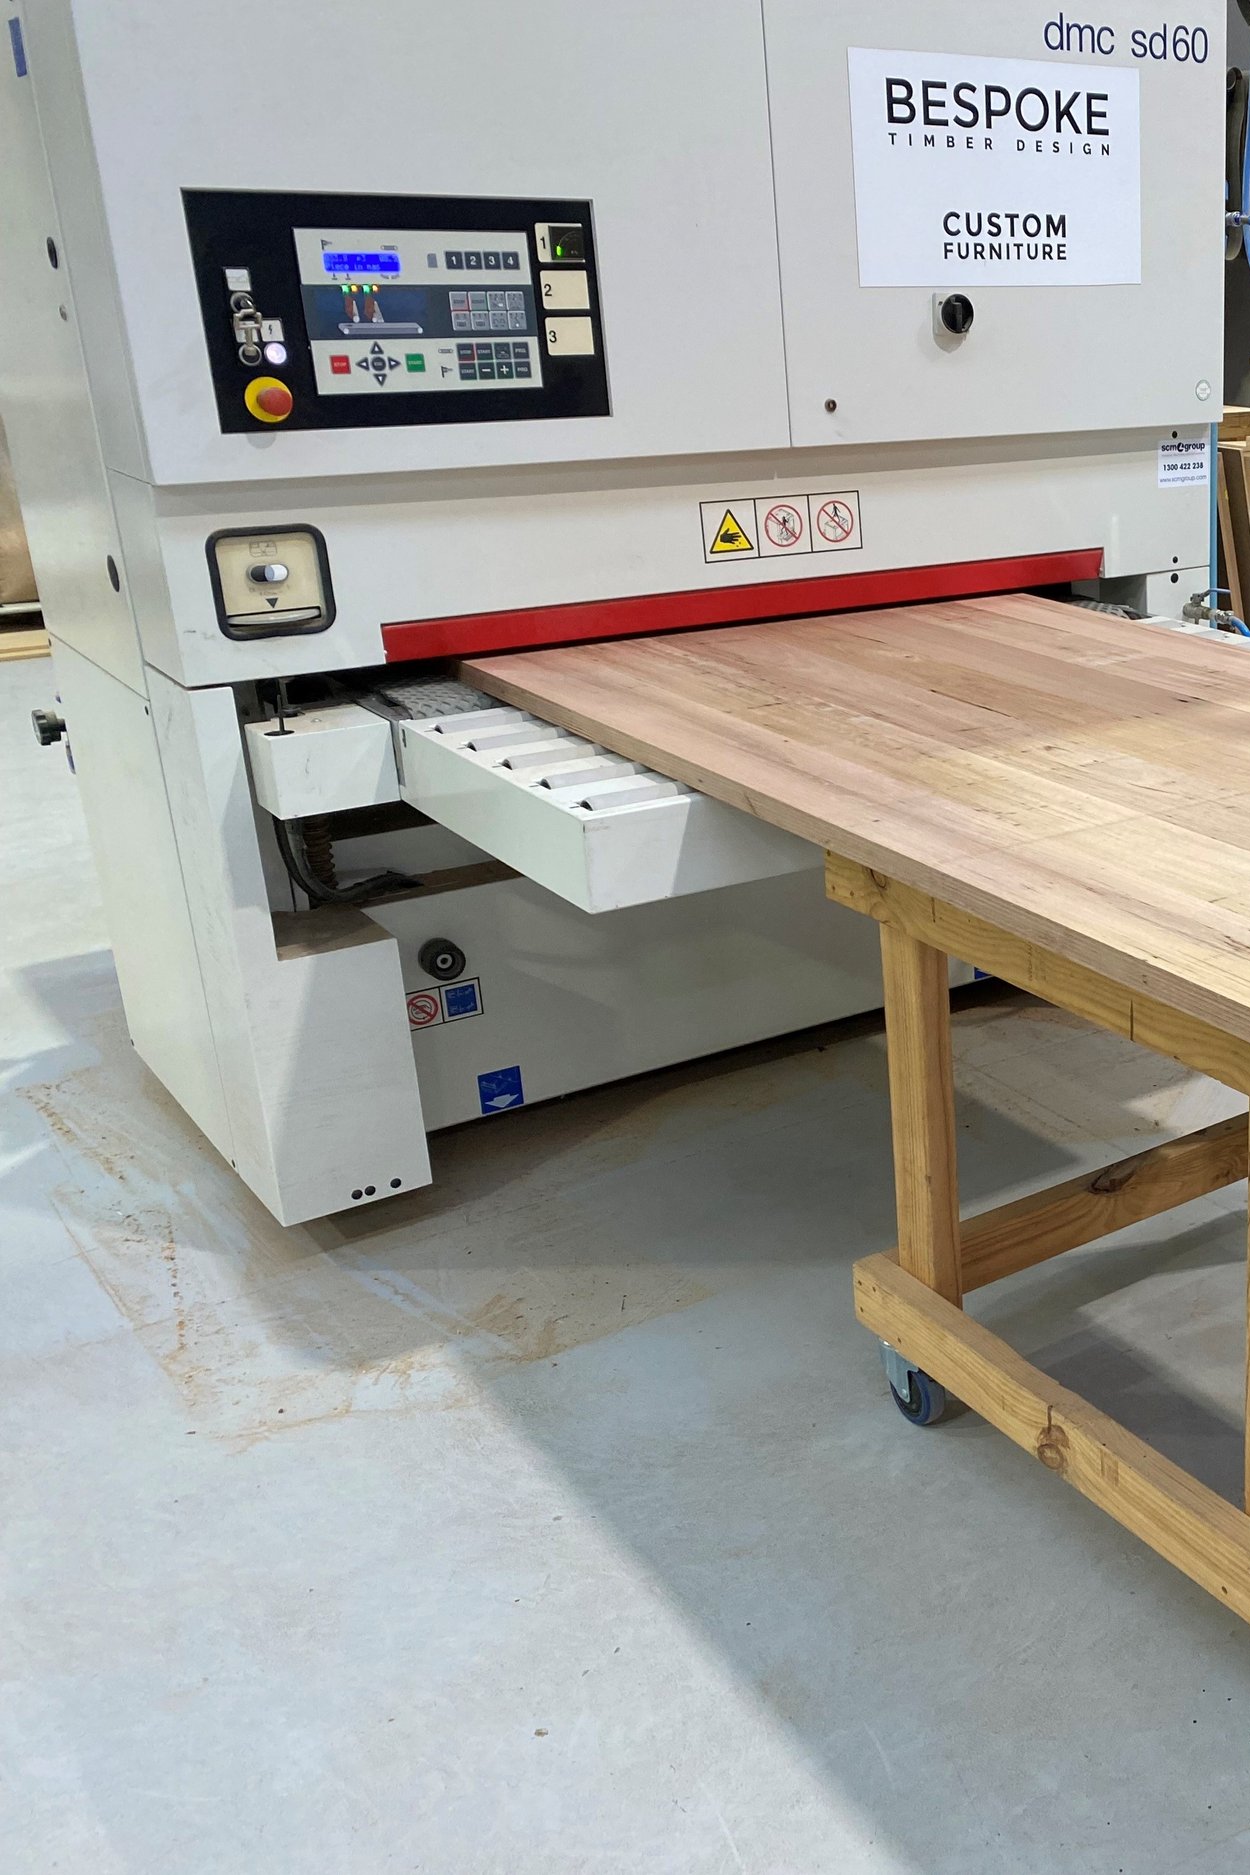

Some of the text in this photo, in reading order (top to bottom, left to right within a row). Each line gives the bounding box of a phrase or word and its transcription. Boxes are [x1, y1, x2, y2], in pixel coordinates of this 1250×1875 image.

[1044, 12, 1115, 55] dmc
[885, 77, 1110, 136] BESPOKE
[888, 132, 1110, 156] TIMBER DESIGN
[943, 211, 1067, 238] CUSTOM
[540, 236, 546, 250] 1
[944, 242, 1067, 260] FURNITURE
[451, 255, 457, 265] 1
[470, 255, 477, 265] 2
[488, 255, 496, 265] 3
[507, 255, 514, 265] 4
[544, 283, 552, 297] 2
[549, 330, 557, 343] 3
[1163, 461, 1204, 471] 1300 422 238
